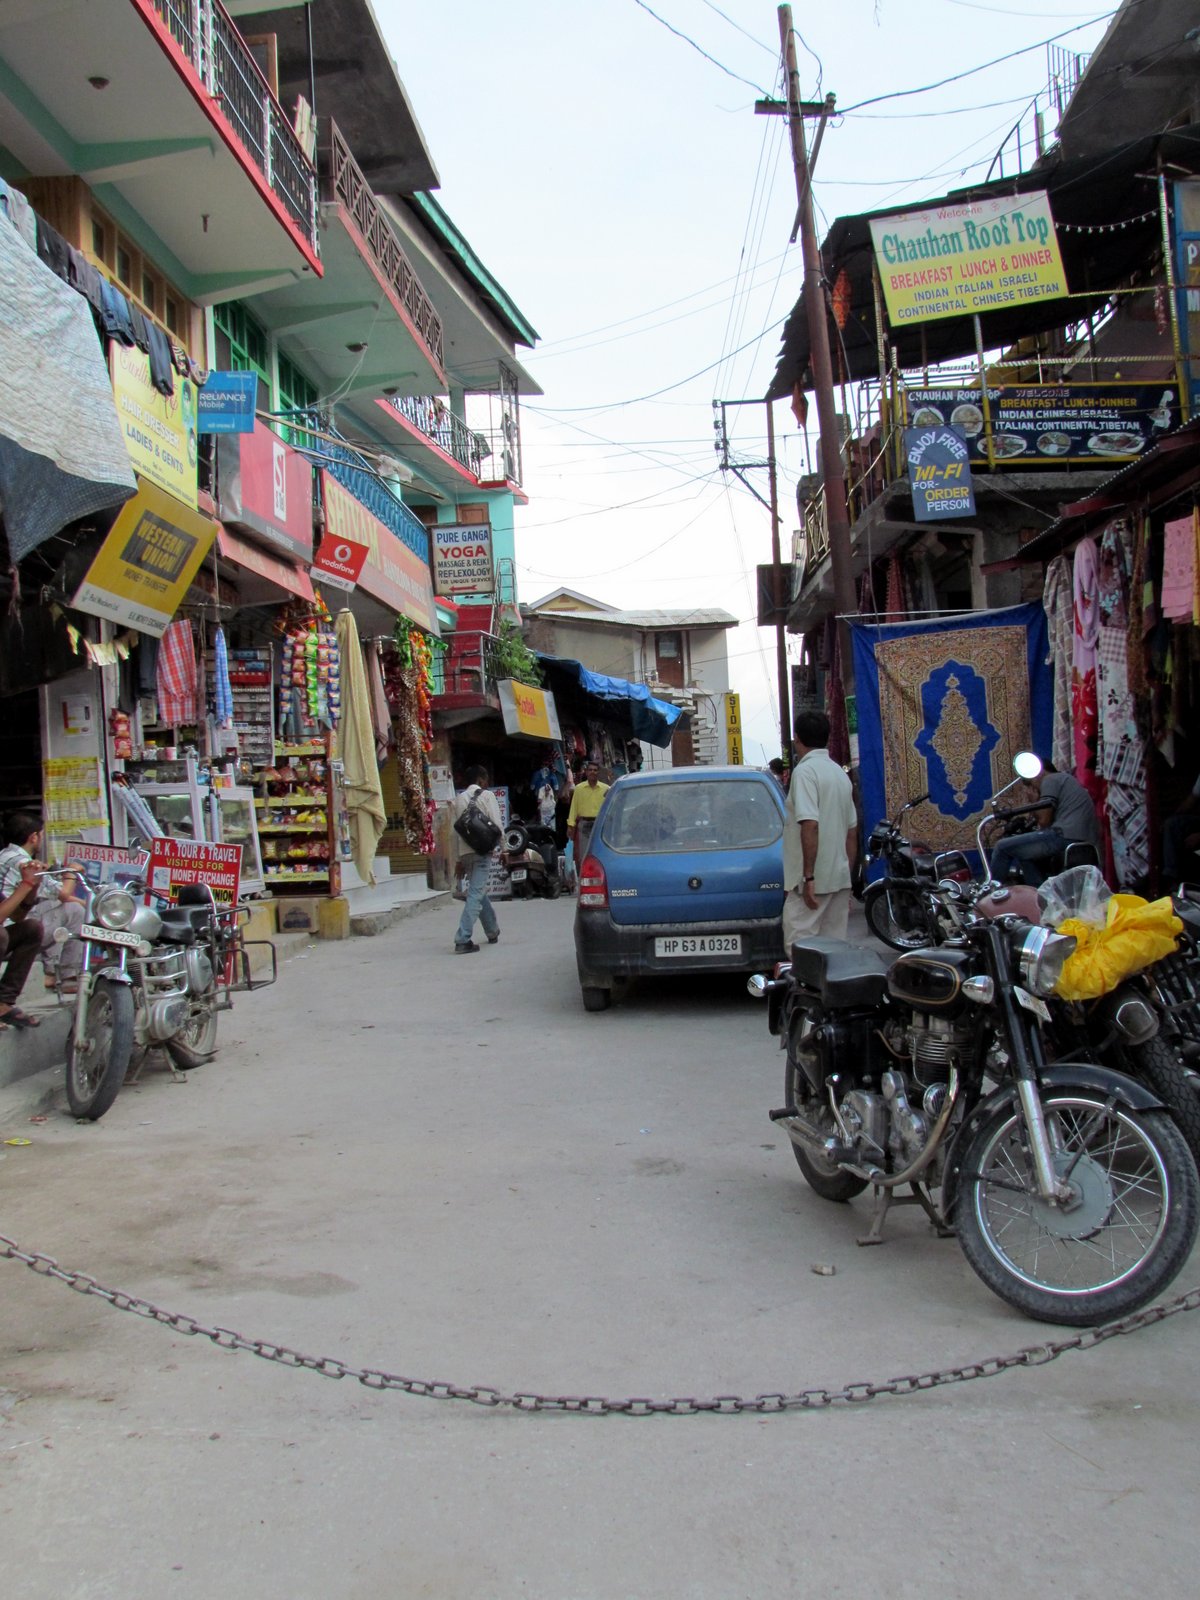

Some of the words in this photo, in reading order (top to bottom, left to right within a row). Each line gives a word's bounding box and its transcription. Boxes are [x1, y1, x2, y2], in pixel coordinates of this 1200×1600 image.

[882, 228, 963, 264] Chauhan
[964, 215, 1011, 250] Roof
[1012, 212, 1048, 245] Top
[890, 266, 953, 290] BREAKFAST
[960, 259, 998, 280] LUNCH
[1001, 257, 1008, 272] &
[1011, 249, 1053, 269] DINNER
[914, 287, 949, 302] INDIAN
[955, 280, 993, 295] ITALIAN
[999, 272, 1038, 287] ISRAELI
[898, 299, 967, 319] CONTINENTAL
[972, 289, 1015, 306] CHINESE
[1017, 283, 1059, 298] TIBETAN
[908, 391, 953, 402] CHAUHAN
[957, 390, 982, 402] ROOF
[1016, 389, 1070, 398] WELCOME
[199, 401, 225, 409] Mobile
[1000, 398, 1057, 408] BREAKFAST
[1063, 398, 1095, 408] LUNCH
[1100, 398, 1137, 407] DINNER
[126, 423, 153, 452] LADIES
[154, 444, 160, 457] &
[162, 449, 184, 475] GENTS
[908, 431, 936, 465] ENJOY
[937, 433, 967, 460] FREE
[914, 463, 963, 481] WI-FI
[925, 486, 969, 501] ORDER
[927, 499, 970, 512] PERSON
[137, 519, 188, 557] WESTERN
[436, 532, 460, 543] PURE
[461, 530, 489, 542] GANGA
[141, 543, 178, 573] UNION
[439, 545, 487, 559] YOGA
[321, 558, 354, 575] vodafone
[438, 560, 465, 568] MASSAGE
[438, 568, 491, 578] REFLEXOLOGY
[68, 845, 115, 862] BARBAR
[117, 851, 148, 867] SHOP
[177, 845, 198, 859] TOUR
[200, 847, 206, 860] &
[207, 847, 238, 863] TRAVEL
[166, 858, 189, 868] VISIT
[191, 859, 204, 869] US
[206, 860, 224, 871] FOR
[172, 869, 196, 882] MONEY
[198, 871, 235, 886] EXCHANGE
[664, 941, 679, 953] HP
[682, 940, 697, 952] 63
[699, 940, 706, 951] A
[708, 938, 738, 951] 0328
